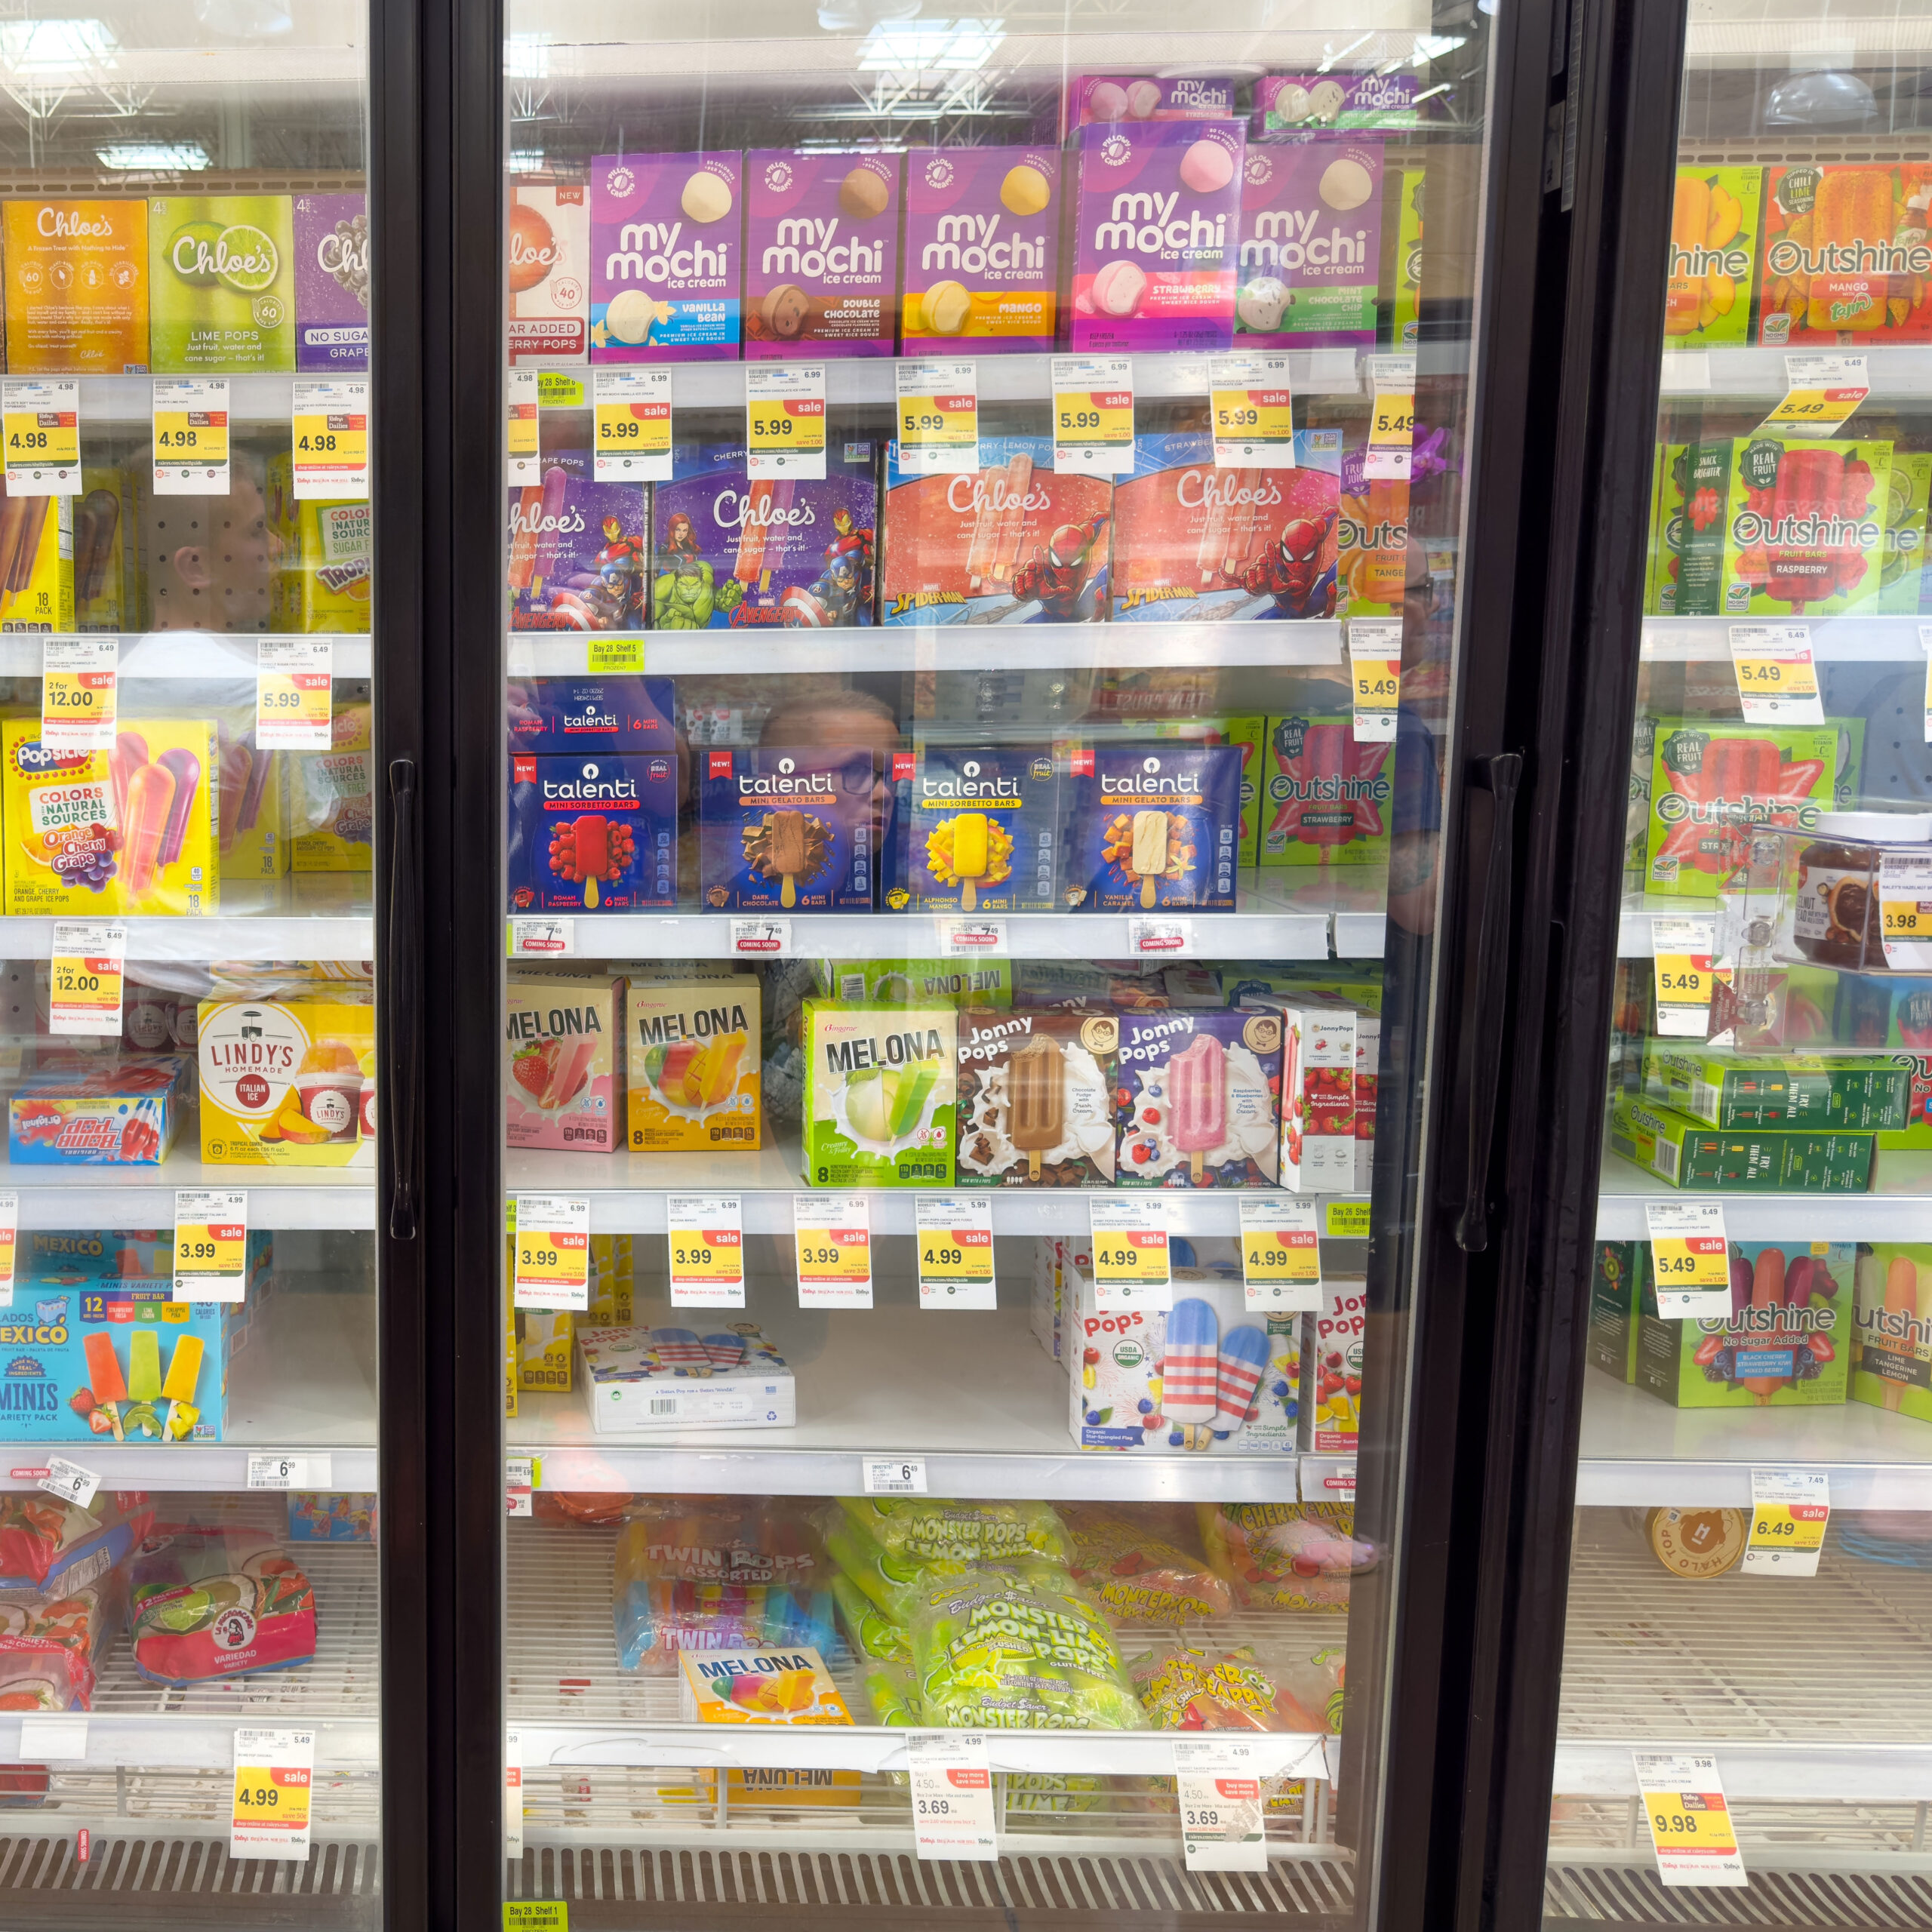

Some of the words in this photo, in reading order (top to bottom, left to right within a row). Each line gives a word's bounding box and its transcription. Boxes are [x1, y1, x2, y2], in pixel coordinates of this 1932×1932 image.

[1111, 192, 1179, 226] my
[38, 208, 112, 238] Chloe's
[1094, 210, 1226, 254] mochi
[620, 223, 681, 258] my
[173, 236, 271, 275] Chloe's
[1161, 248, 1179, 259] ice
[1183, 248, 1223, 259] cream
[1769, 238, 1932, 275] Outshine
[606, 241, 726, 281] mochi
[668, 277, 683, 288] ice
[686, 278, 725, 288] cream
[1153, 284, 1220, 294] STRAWBERRY
[1829, 283, 1868, 291] MANGO
[682, 303, 724, 312] VANILLA
[843, 300, 880, 308] DOUBLE
[1000, 303, 1041, 313] MANGO
[263, 308, 276, 317] 60
[698, 313, 725, 321] BEAN
[824, 309, 880, 319] CHOCOLATE
[192, 332, 220, 340] LIME
[225, 331, 258, 340] POPS
[187, 344, 202, 352] Just
[205, 343, 220, 352] fruit,
[645, 405, 667, 417] sale
[1780, 404, 1824, 414] 5.49
[601, 423, 639, 438] 5.99
[11, 433, 47, 448] 4.98
[299, 435, 336, 451] 4.98
[1753, 452, 1776, 464] REAL
[1753, 464, 1776, 475] FRUIT
[947, 473, 1050, 513] Chloe's
[714, 490, 815, 528] Chloe's
[1732, 512, 1880, 546] Outshine
[1777, 565, 1827, 574] RASPBERRY
[35, 592, 48, 605] 18
[891, 589, 966, 614] SPIDER-MAN
[35, 606, 52, 614] PACK
[728, 601, 797, 629] AVENGERS
[594, 645, 604, 654] Bay
[606, 645, 613, 653] 28
[617, 645, 630, 653] Shelf
[632, 645, 635, 653] 5
[91, 675, 113, 685] sale
[1742, 666, 1780, 681] 5.49
[1359, 680, 1397, 695] 5.49
[49, 692, 93, 706] 12.00
[263, 693, 300, 707] 5.99
[544, 779, 636, 798] talenti
[739, 774, 832, 795] talenti
[923, 777, 1019, 796] talenti
[1269, 774, 1391, 801] Outshine
[40, 789, 103, 804] COLORS
[47, 801, 105, 814] NATURAL
[42, 811, 106, 826] SOURCES
[43, 828, 91, 846] Orange
[63, 838, 106, 853] Cherry
[52, 853, 95, 869] Grape
[1886, 915, 1916, 928] 3.98
[57, 977, 98, 991] 12.00
[639, 1005, 748, 1046] MELONA
[970, 1017, 1032, 1044] Jonny
[211, 1044, 293, 1067] LINDY'S
[826, 1028, 946, 1073] MELONA
[958, 1041, 1008, 1064] Pops
[240, 1084, 266, 1093] ITALIAN
[22, 1115, 61, 1129] Original
[1749, 1145, 1760, 1164] THEM
[1759, 1156, 1770, 1170] TRY
[1747, 1167, 1757, 1179] ALL
[221, 1228, 242, 1238] sale
[563, 1236, 584, 1246] sale
[1700, 1241, 1722, 1250] sale
[180, 1244, 215, 1258] 3.99
[522, 1251, 557, 1265] 3.99
[924, 1249, 961, 1265] 4.99
[1659, 1258, 1695, 1273] 5.49
[85, 1297, 102, 1312] 12
[1084, 1312, 1143, 1337] Pops
[1724, 1337, 1736, 1345] No
[1739, 1337, 1770, 1346] Sugar
[1774, 1335, 1807, 1345] Added
[1875, 1360, 1917, 1374] TANGERINE
[1881, 1370, 1909, 1380] LEMON
[1803, 1509, 1824, 1518] sale
[1757, 1522, 1794, 1536] 6.49
[1661, 1529, 1677, 1558] TOP
[645, 1545, 724, 1567] TWIN
[730, 1550, 815, 1570] POPS
[1679, 1556, 1722, 1573] HALO
[685, 1567, 772, 1581] ASSORTED
[214, 1650, 257, 1663] VARIEDAD
[697, 1655, 813, 1678] MELONA
[981, 1697, 1016, 1709] Budget
[238, 1789, 278, 1806] 4.99
[918, 1801, 949, 1814] 3.69
[1657, 1815, 1697, 1832] 9.98
[510, 1906, 521, 1917] Bay
[524, 1906, 532, 1915] 28
[536, 1906, 552, 1915] Shelf
[554, 1906, 558, 1915] 1
